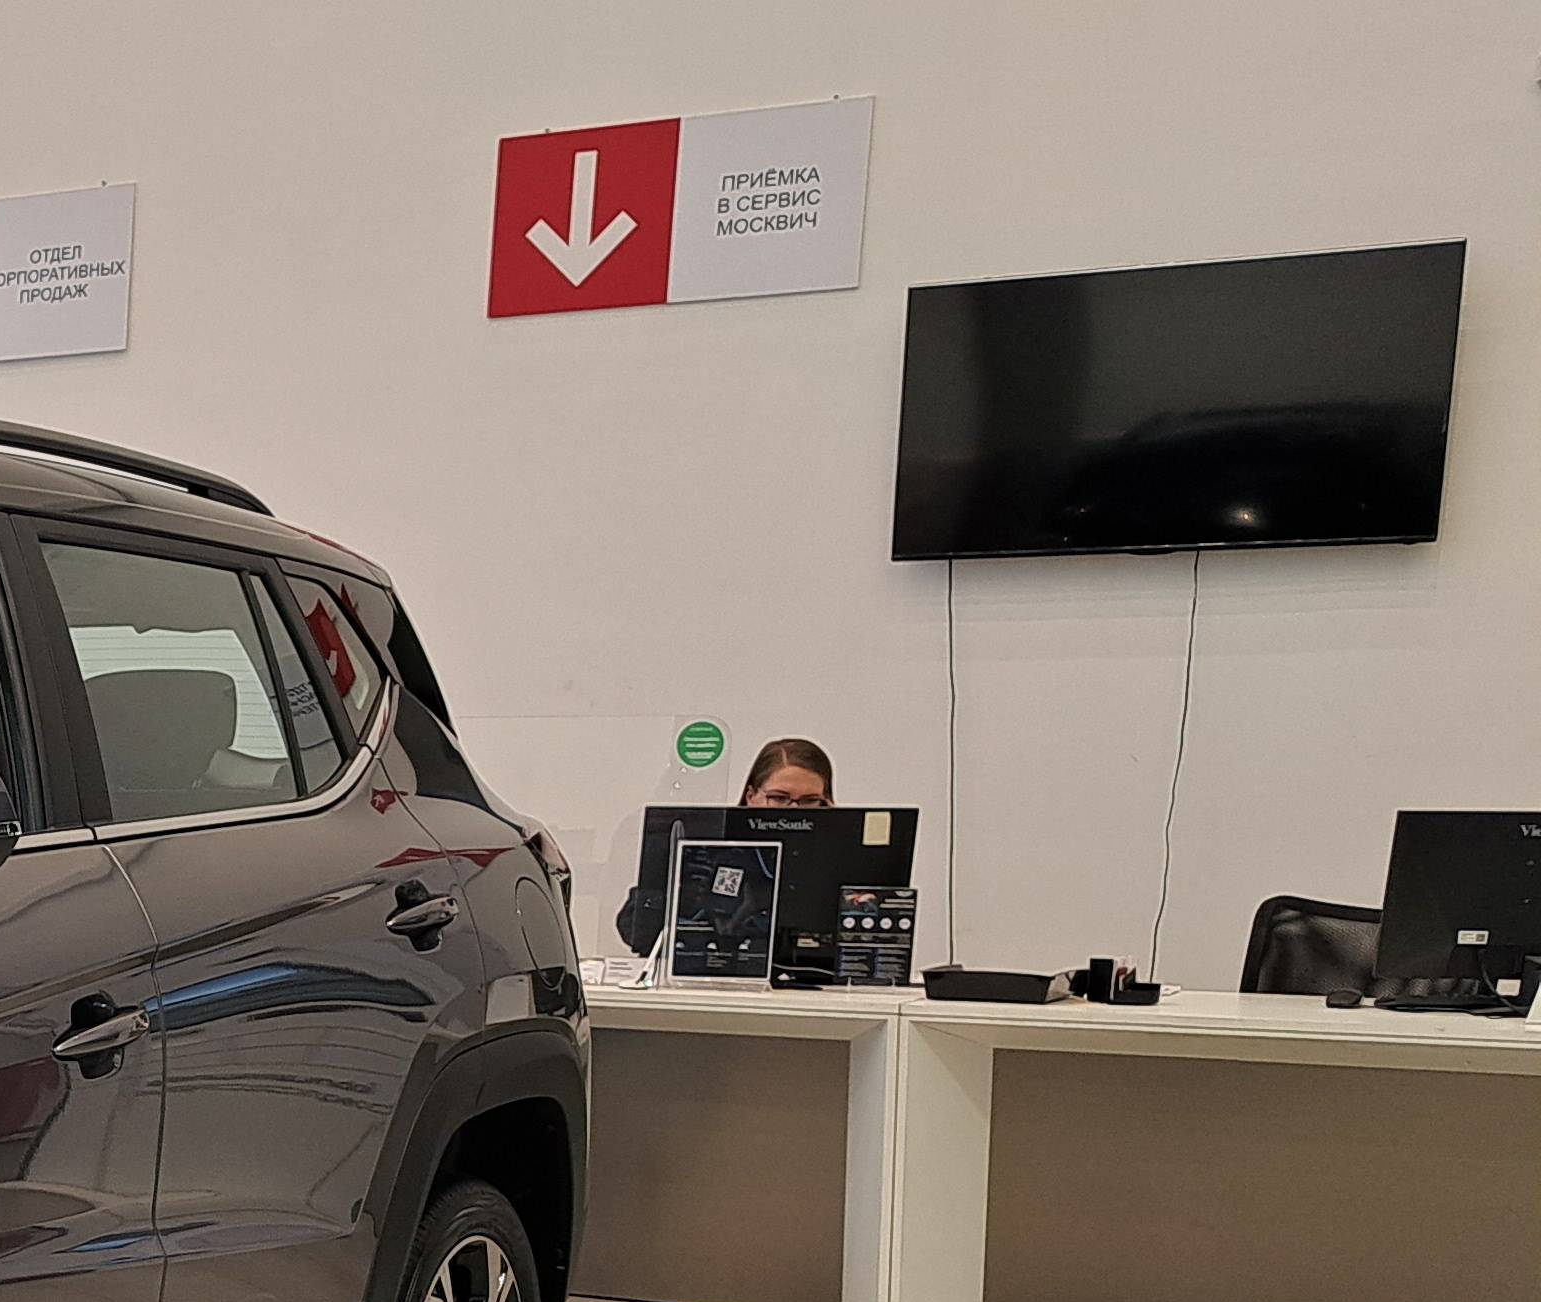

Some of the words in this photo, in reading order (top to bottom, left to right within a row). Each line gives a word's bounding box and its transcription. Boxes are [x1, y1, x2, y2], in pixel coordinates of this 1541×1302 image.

[721, 166, 821, 192] ПРИЁМКА
[717, 197, 730, 215] В
[736, 188, 822, 213] СЕРВИС
[716, 210, 818, 237] МОСКВИЧ
[29, 244, 83, 266] ОТДЕЛ
[19, 283, 89, 305] ПРОДАЖ
[748, 818, 814, 831] ViewSonic
